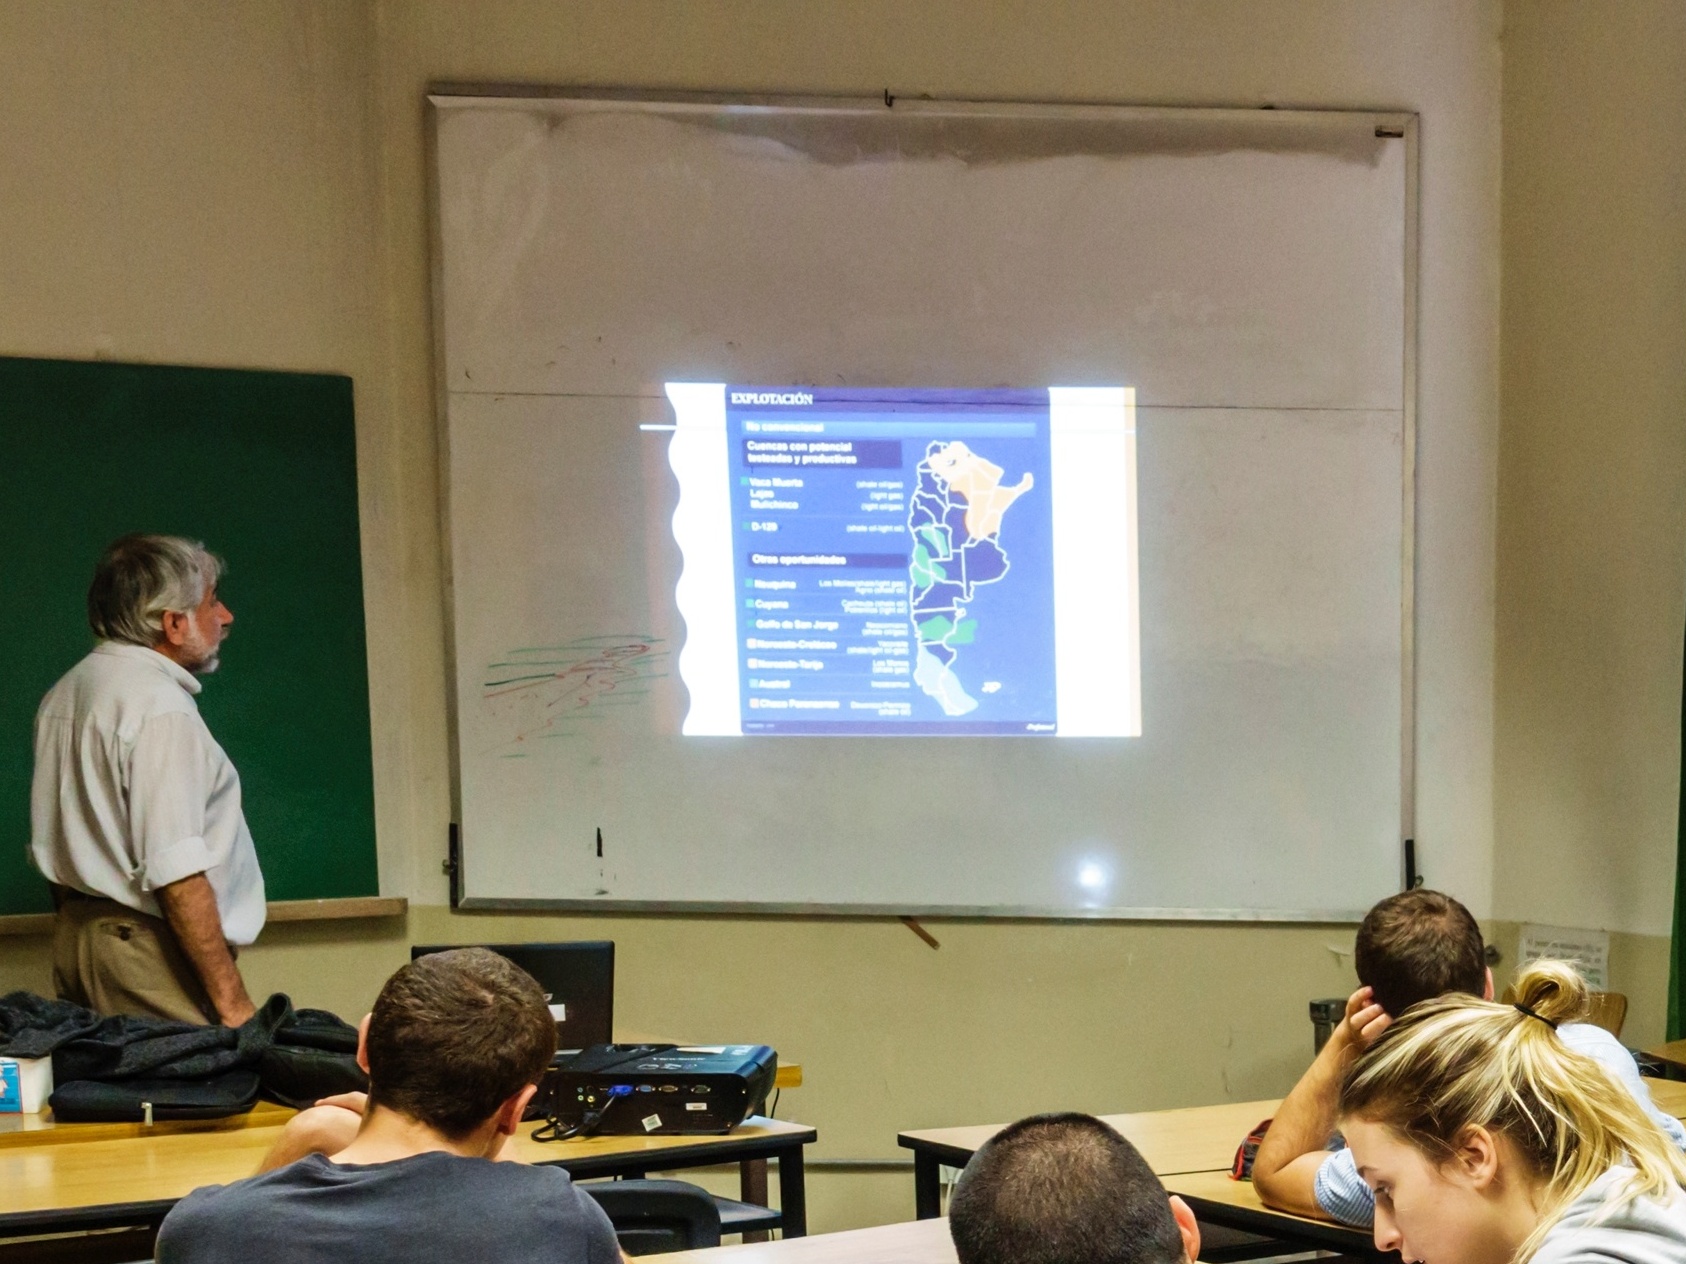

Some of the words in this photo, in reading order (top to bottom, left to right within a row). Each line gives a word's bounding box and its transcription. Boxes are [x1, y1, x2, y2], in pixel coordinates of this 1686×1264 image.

[731, 392, 813, 405] EXPLOTACIÓN
[746, 422, 760, 432] No
[747, 441, 788, 451] Cuencas
[789, 443, 808, 451] con
[809, 442, 852, 453] potencial
[794, 456, 800, 465] y
[752, 554, 778, 564] Otras
[780, 555, 847, 566] oportunidades
